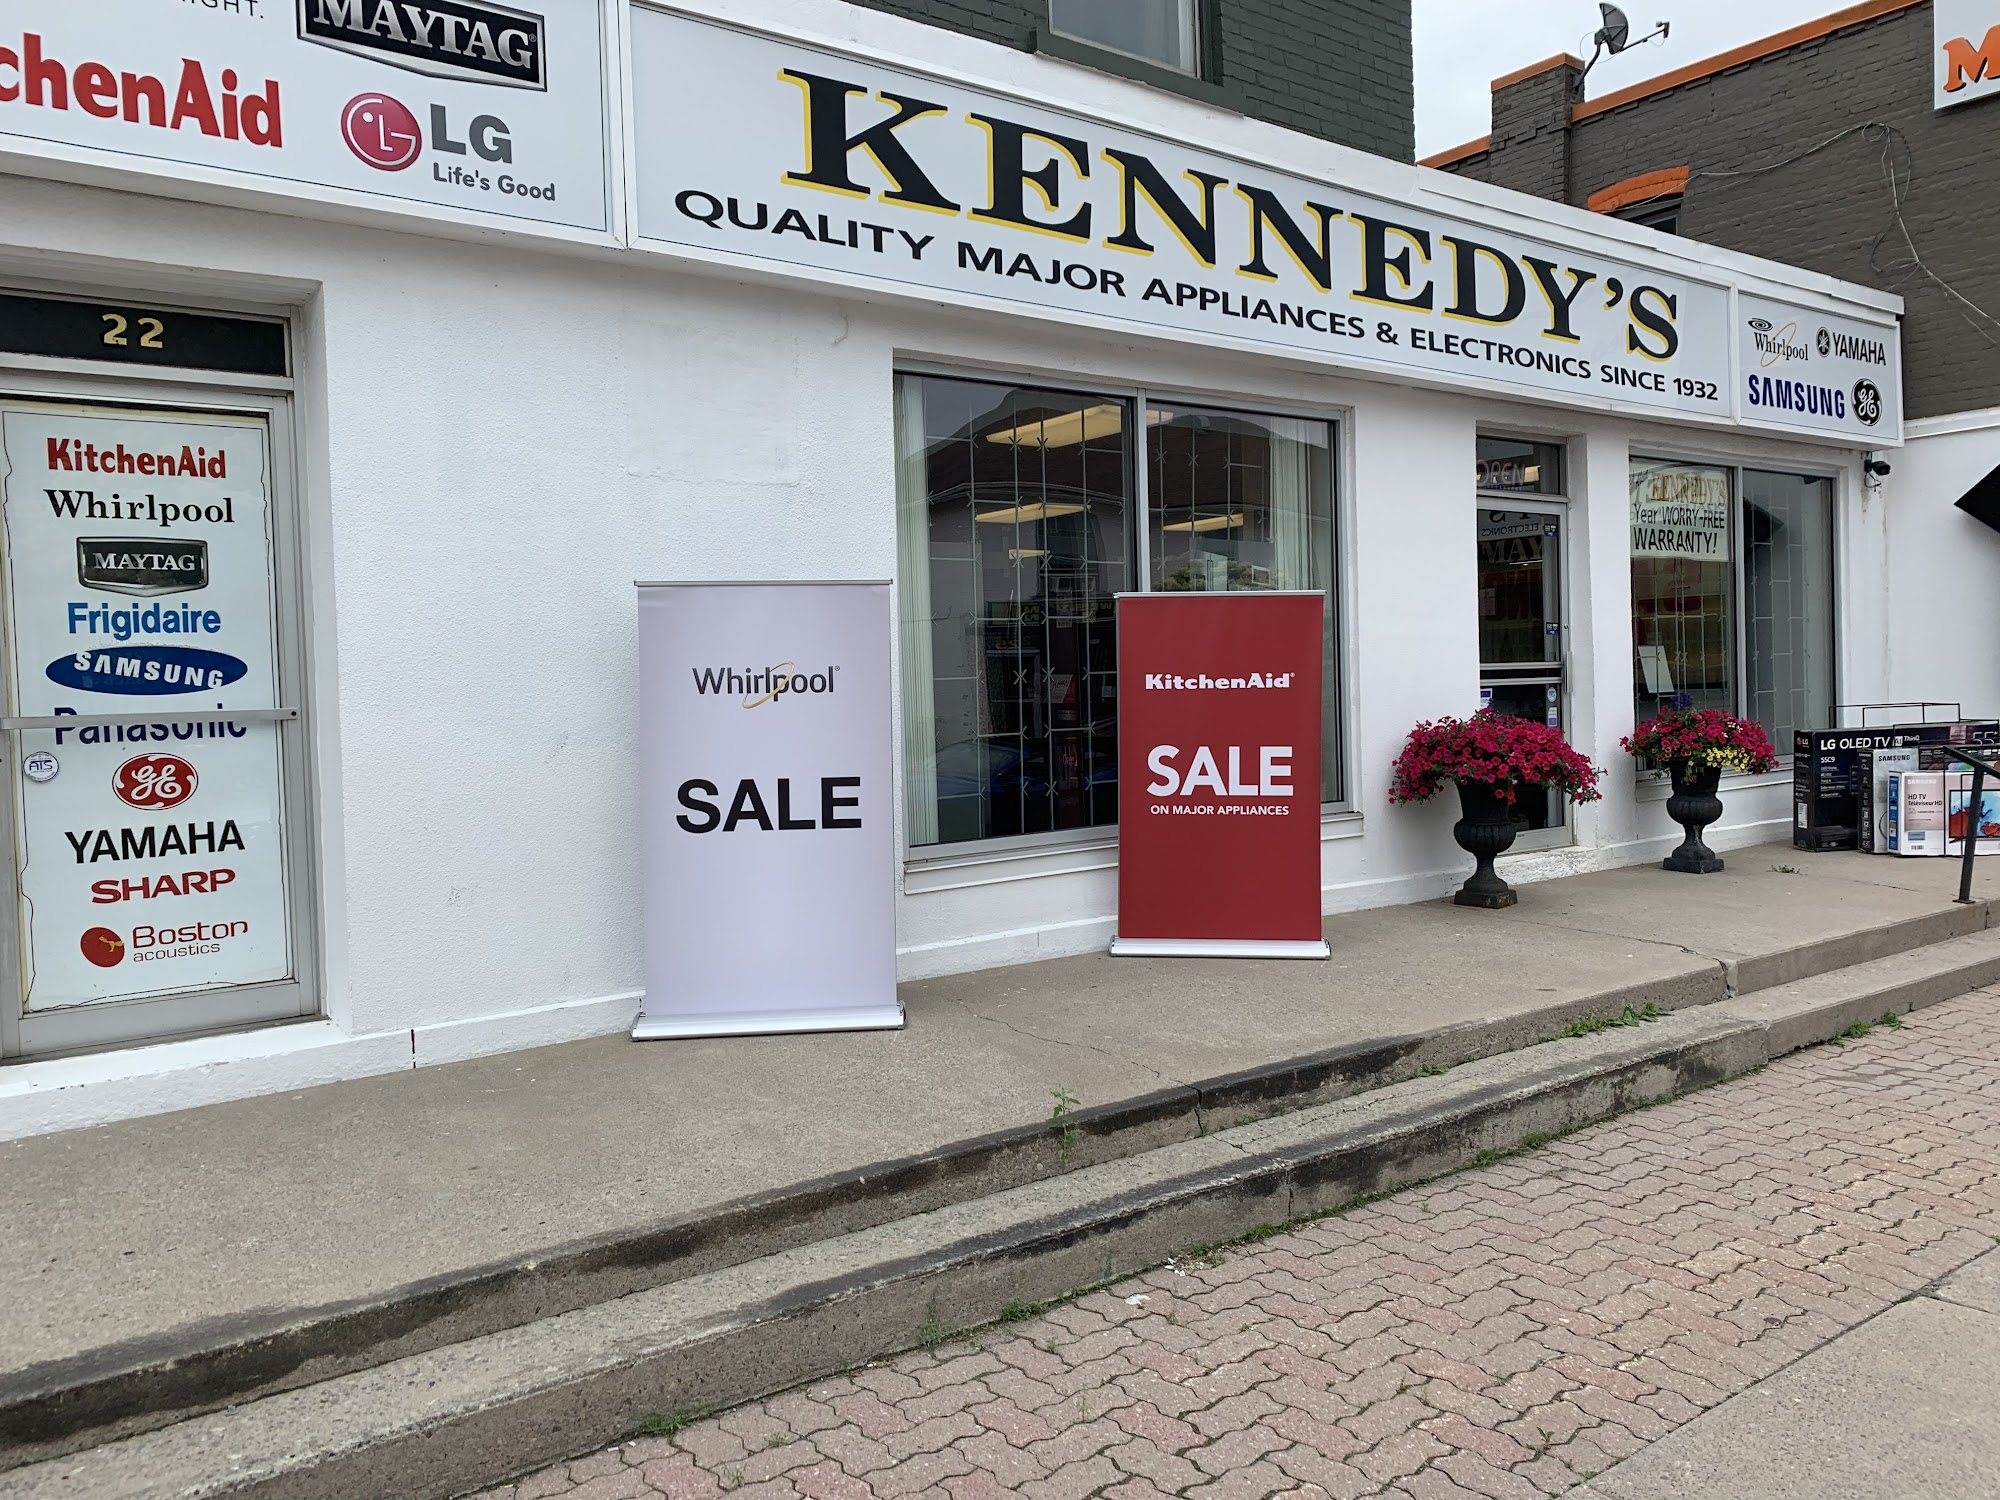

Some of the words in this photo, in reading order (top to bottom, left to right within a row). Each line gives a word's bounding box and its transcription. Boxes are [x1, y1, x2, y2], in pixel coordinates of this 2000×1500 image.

[314, 0, 533, 70] MAYTAG
[430, 104, 513, 165] LG
[433, 163, 490, 192] Life's
[498, 174, 556, 202] Good
[776, 67, 1679, 363] KENNEDY'S
[674, 189, 935, 260] QUALITY
[957, 241, 1126, 297] MAJOR
[1141, 277, 1366, 339] APPLIANCES
[1376, 321, 1399, 345] &
[1410, 328, 1592, 380] ELECTRONICS
[1600, 364, 1666, 393] SINCE
[1672, 377, 1719, 401] 1932
[101, 313, 165, 349] 22
[1753, 331, 1810, 361] Whirlpool
[1832, 331, 1887, 367] YAMAHA
[1748, 373, 1846, 420] SAMSUNG
[46, 437, 227, 479] KitchenAid
[43, 488, 236, 528] Whirlpool
[1633, 503, 1658, 525] Year
[1661, 505, 1726, 529] WORRY-FREE
[1633, 527, 1718, 554] WARRANTY!
[91, 552, 196, 572] MAYTAG
[66, 602, 222, 641] Frigidaire
[73, 650, 225, 689] SAMSUNG
[691, 664, 835, 702] Whirlpool
[1145, 672, 1291, 690] KitchenAid
[1820, 739, 1836, 750] LG
[1839, 737, 1872, 750] OLED
[1873, 736, 1890, 749] TV
[1878, 754, 1911, 762] SAMSUNG
[1146, 744, 1294, 797] SALE
[676, 776, 863, 834] SALE
[1150, 805, 1169, 815] ON
[1172, 805, 1214, 816] MAJOR
[1217, 805, 1290, 816] APPLIANCES
[63, 818, 246, 865] YAMAHA
[90, 868, 236, 905] SHARP
[131, 919, 249, 949] Boston
[132, 941, 221, 963] acoustics
